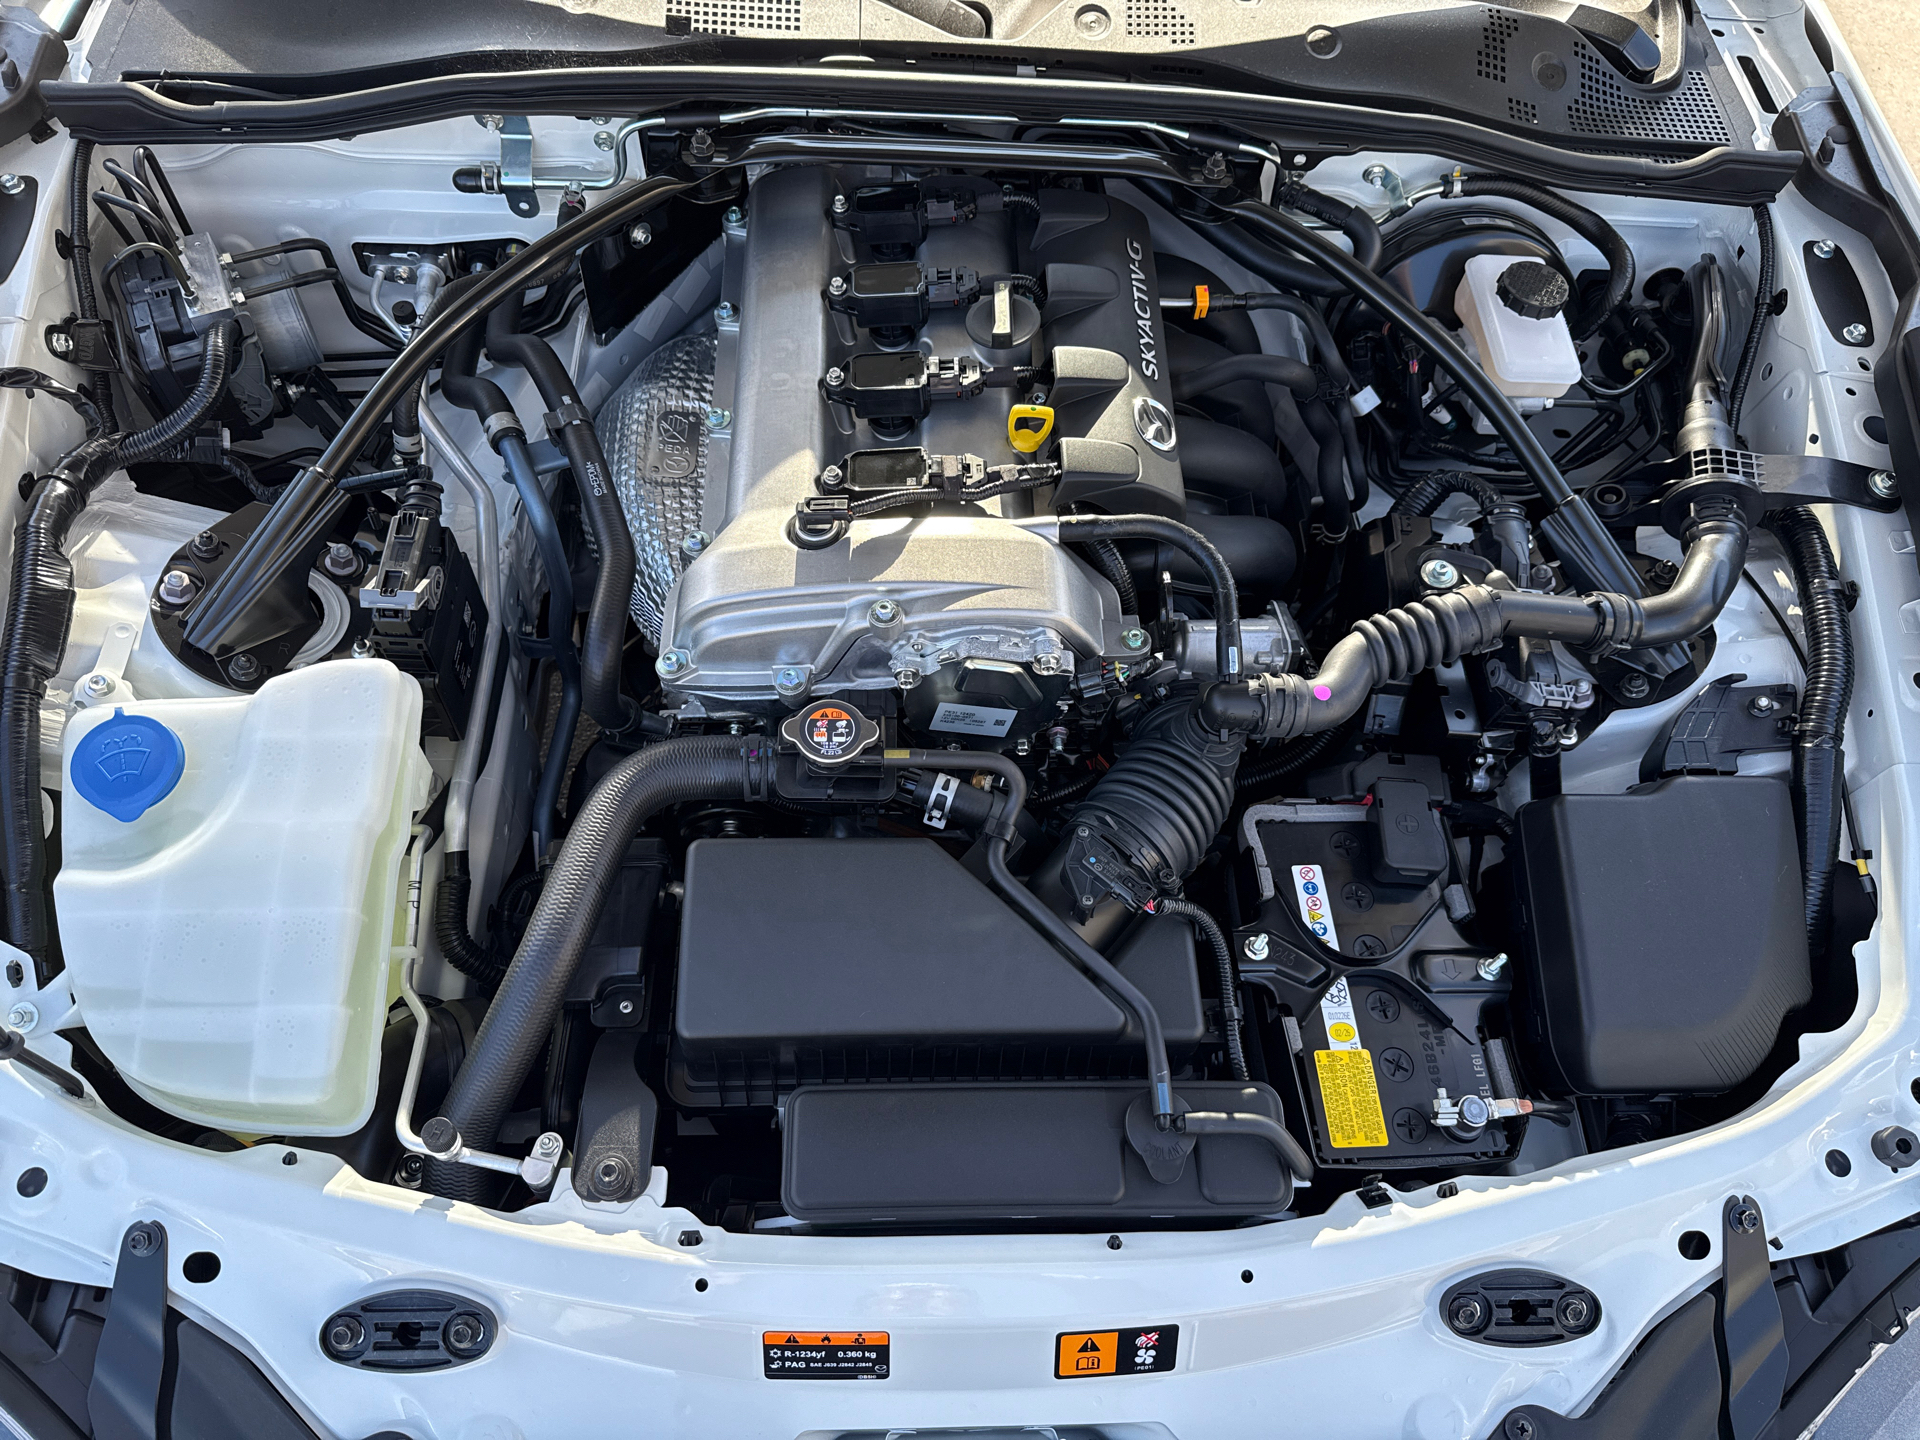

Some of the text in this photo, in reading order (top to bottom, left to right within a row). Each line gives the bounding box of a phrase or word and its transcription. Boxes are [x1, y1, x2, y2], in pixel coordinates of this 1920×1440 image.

[1126, 237, 1159, 381] SKYACTIV-G
[1338, 1063, 1348, 1088] POISON
[1471, 1054, 1486, 1078] LFG1
[1365, 1065, 1376, 1094] DANGER
[1371, 1095, 1380, 1119] EXPLOSIVE
[784, 1350, 826, 1358] R-1234yf
[864, 1350, 876, 1358] kg
